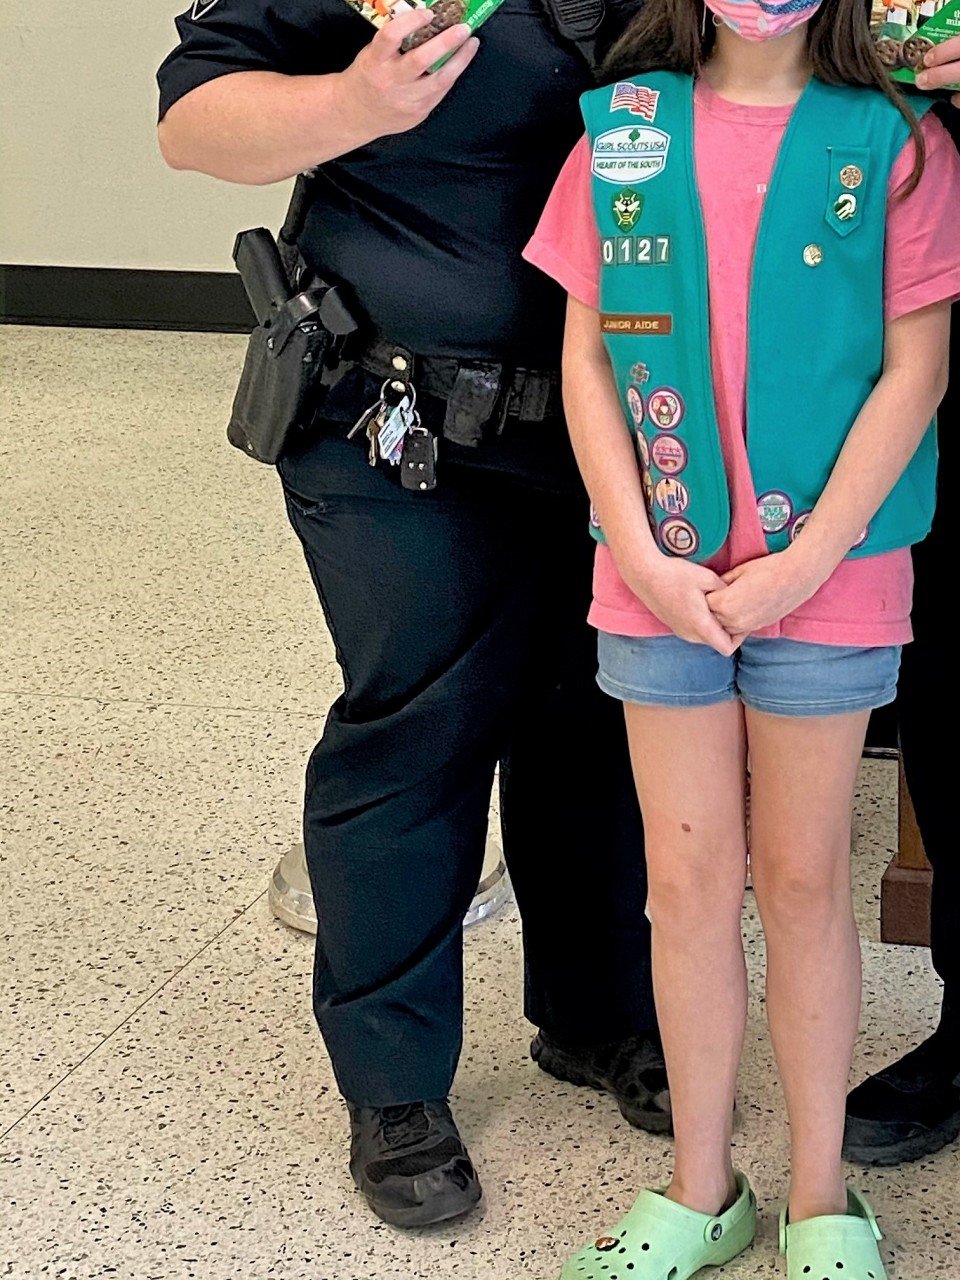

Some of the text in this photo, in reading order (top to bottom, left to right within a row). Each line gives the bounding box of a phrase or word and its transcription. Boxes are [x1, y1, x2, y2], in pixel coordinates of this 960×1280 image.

[597, 140, 666, 152] GIRL SCOUTS USA
[597, 160, 661, 170] HEART OF THE SOUTH
[602, 237, 670, 263] 0127
[634, 320, 660, 330] AIDE
